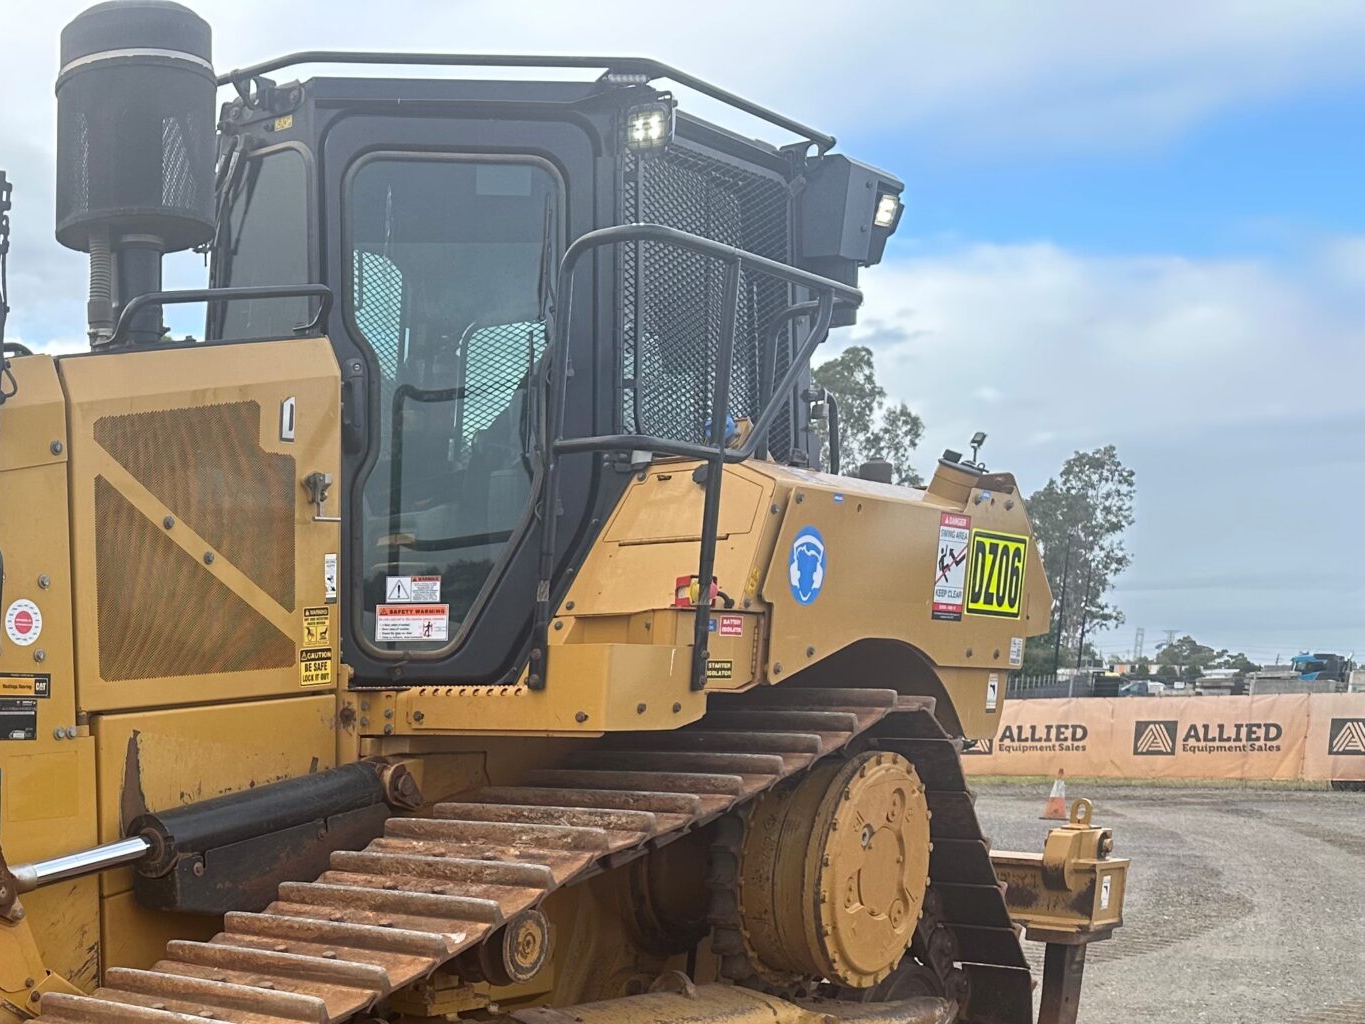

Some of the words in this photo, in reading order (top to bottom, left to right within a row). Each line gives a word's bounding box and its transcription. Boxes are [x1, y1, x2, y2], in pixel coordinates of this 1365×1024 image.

[947, 590, 962, 599] CLEAR
[304, 663, 312, 672] BE
[313, 662, 327, 672] SAFE
[303, 674, 314, 682] LOCK
[35, 682, 47, 691] CAT
[998, 724, 1088, 743] ALLIED
[1182, 723, 1283, 742] ALLIED
[998, 743, 1057, 754] Equipment
[1058, 743, 1087, 752] Sales
[1182, 743, 1247, 754] Equipment
[1249, 743, 1281, 752] Sales
